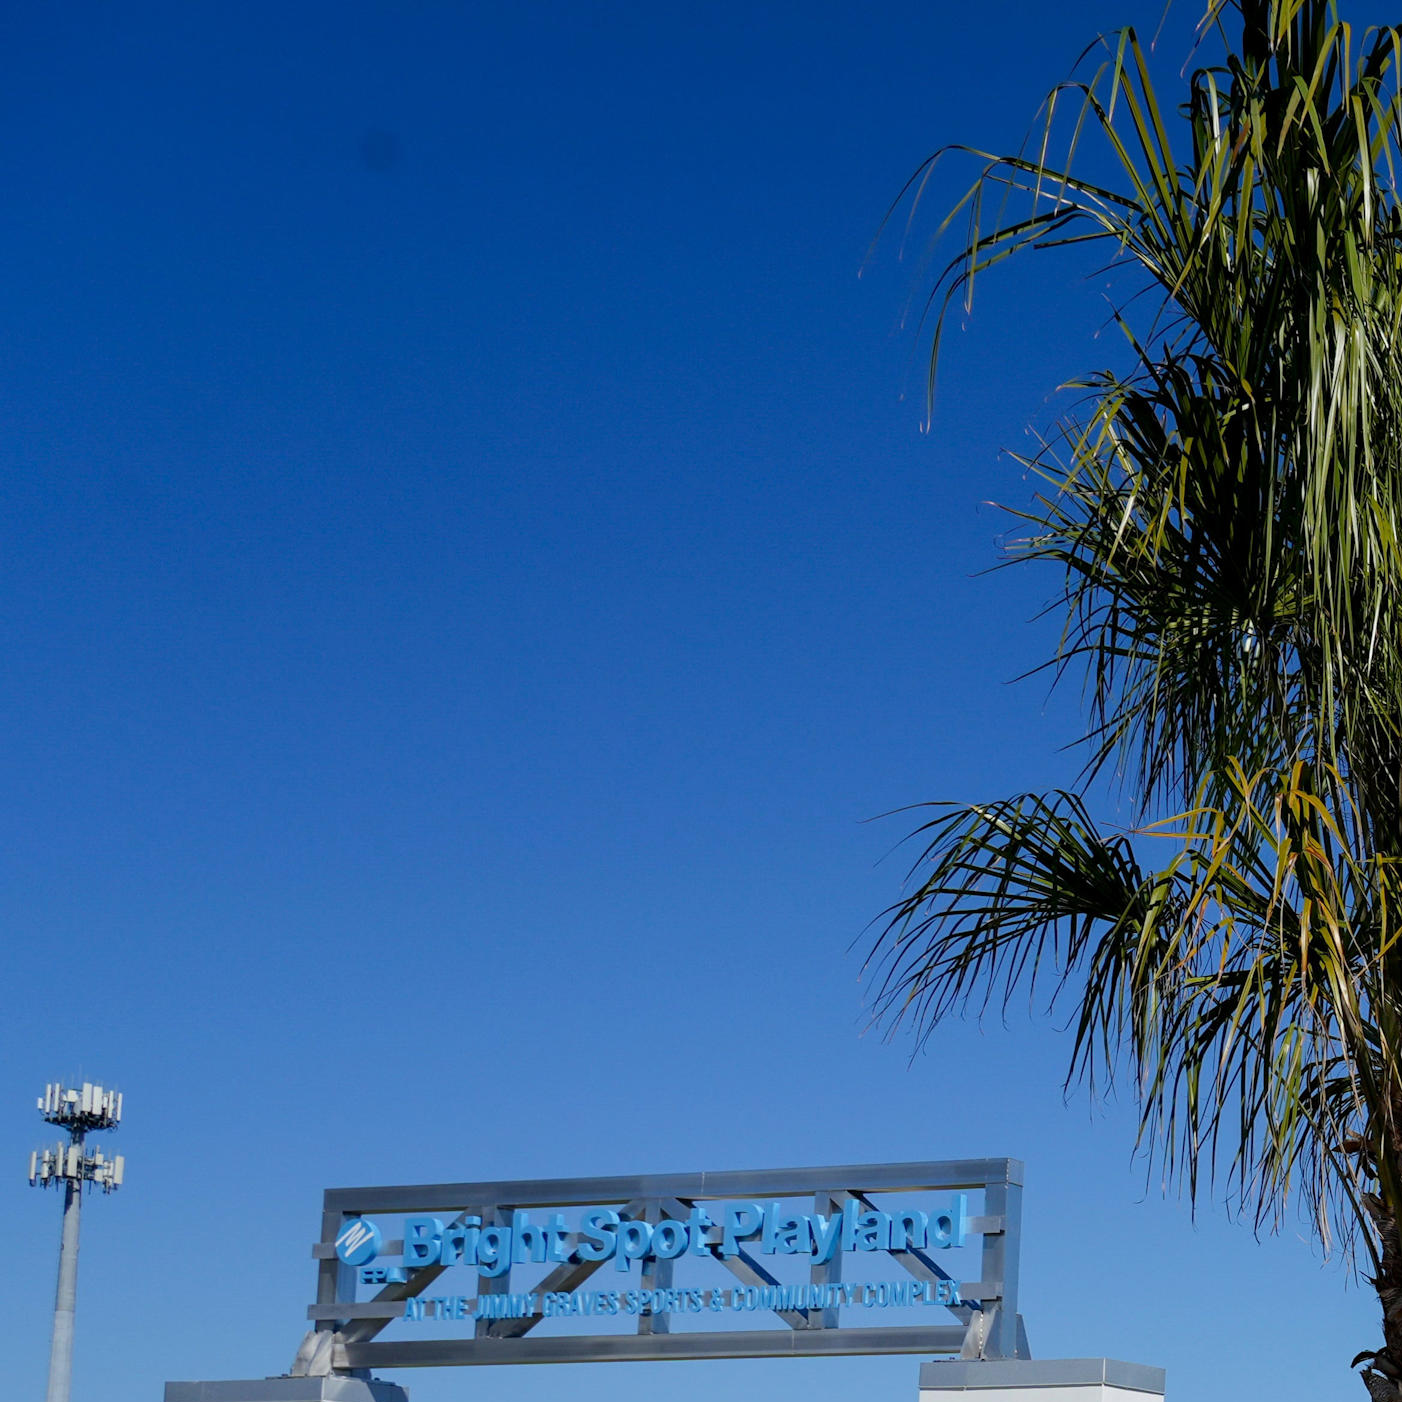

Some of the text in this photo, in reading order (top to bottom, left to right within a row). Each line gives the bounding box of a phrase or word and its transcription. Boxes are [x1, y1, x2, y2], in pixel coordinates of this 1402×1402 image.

[403, 1194, 967, 1278] Bright Spot Playland
[403, 1279, 961, 1321] AT THE JIMMY GRAVES SPORTS & COMMUNITY COMPLEX
